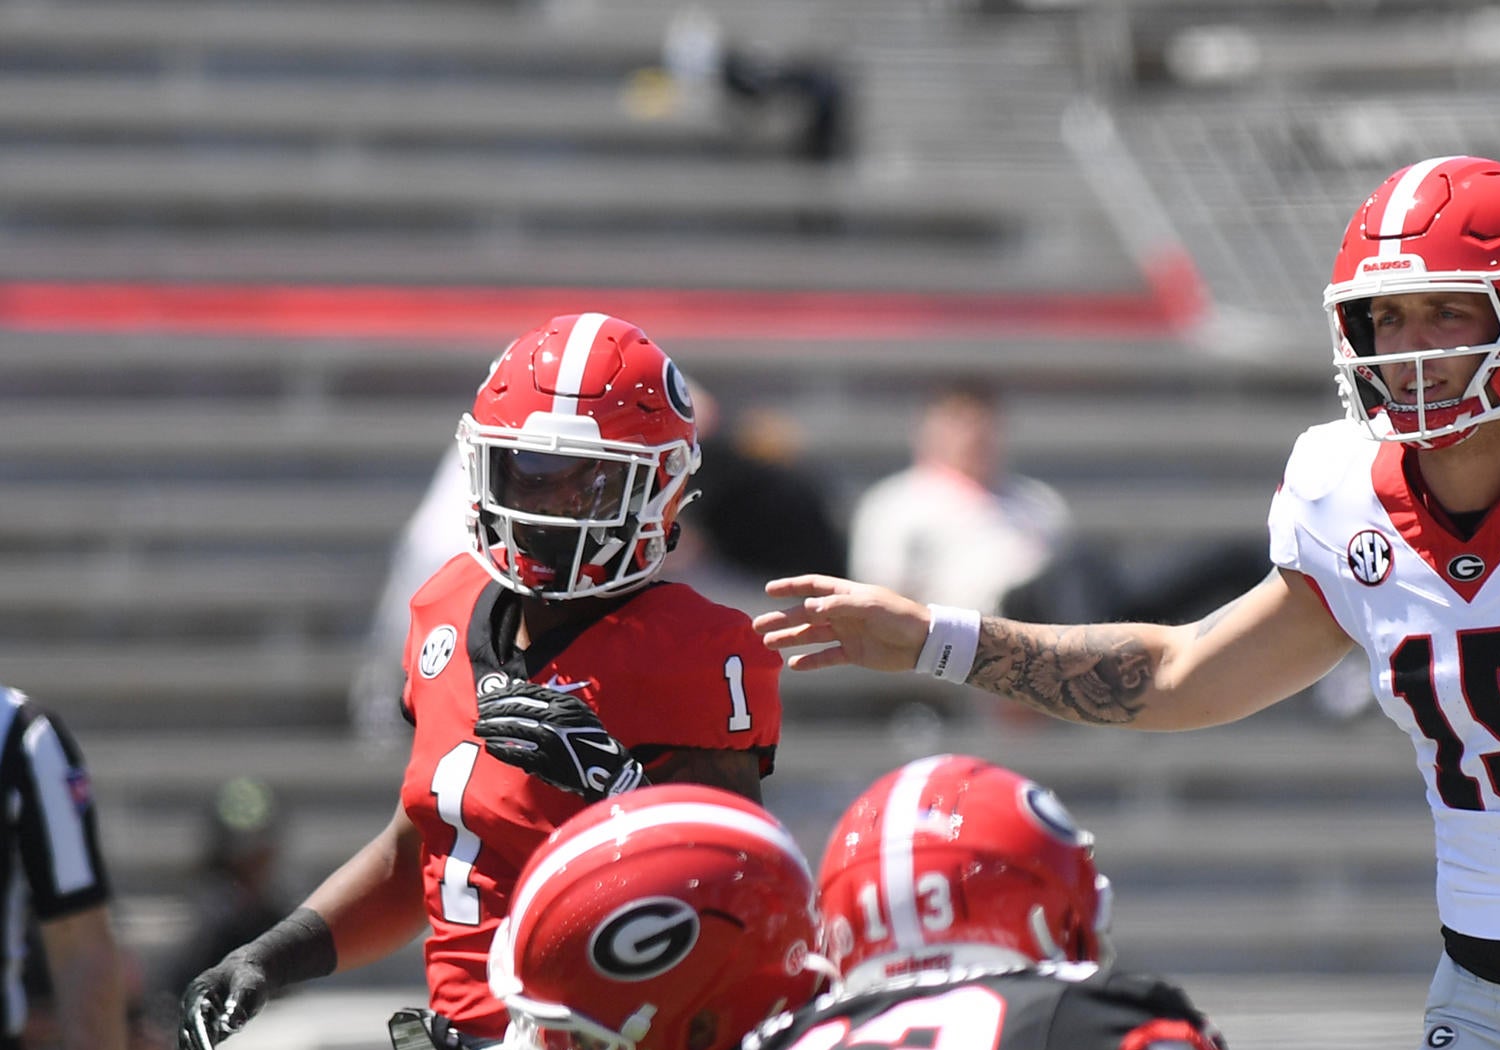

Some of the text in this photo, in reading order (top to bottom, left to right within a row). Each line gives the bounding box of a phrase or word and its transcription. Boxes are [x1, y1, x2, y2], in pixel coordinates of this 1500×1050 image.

[1363, 259, 1412, 273] DAWGS
[1349, 531, 1391, 583] SEC
[1449, 555, 1484, 581] G
[724, 655, 752, 733] 1
[430, 740, 482, 927] 1
[593, 903, 695, 976] G
[1427, 1025, 1456, 1049] G
